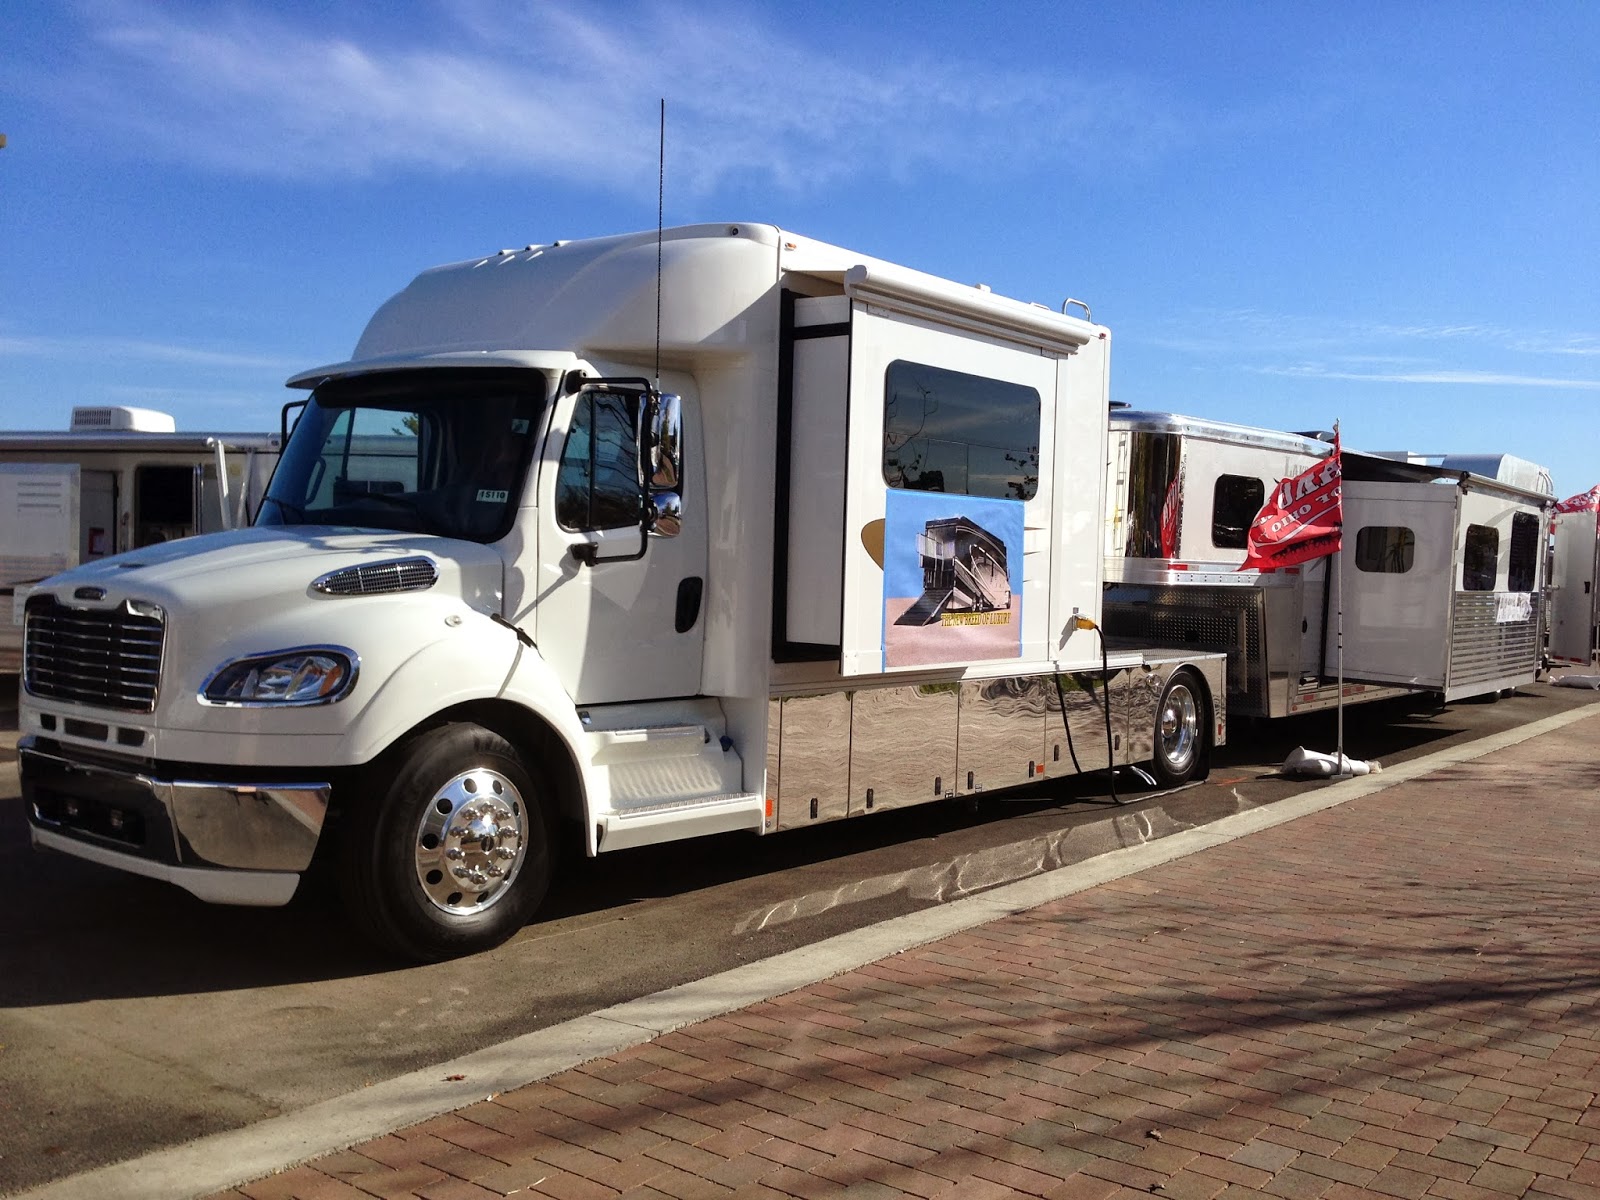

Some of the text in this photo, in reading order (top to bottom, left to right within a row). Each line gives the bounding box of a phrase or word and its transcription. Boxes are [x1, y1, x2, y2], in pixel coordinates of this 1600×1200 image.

[941, 614, 951, 627] THE
[951, 613, 964, 626] NEW
[964, 613, 981, 625] BREED
[982, 613, 990, 625] OF
